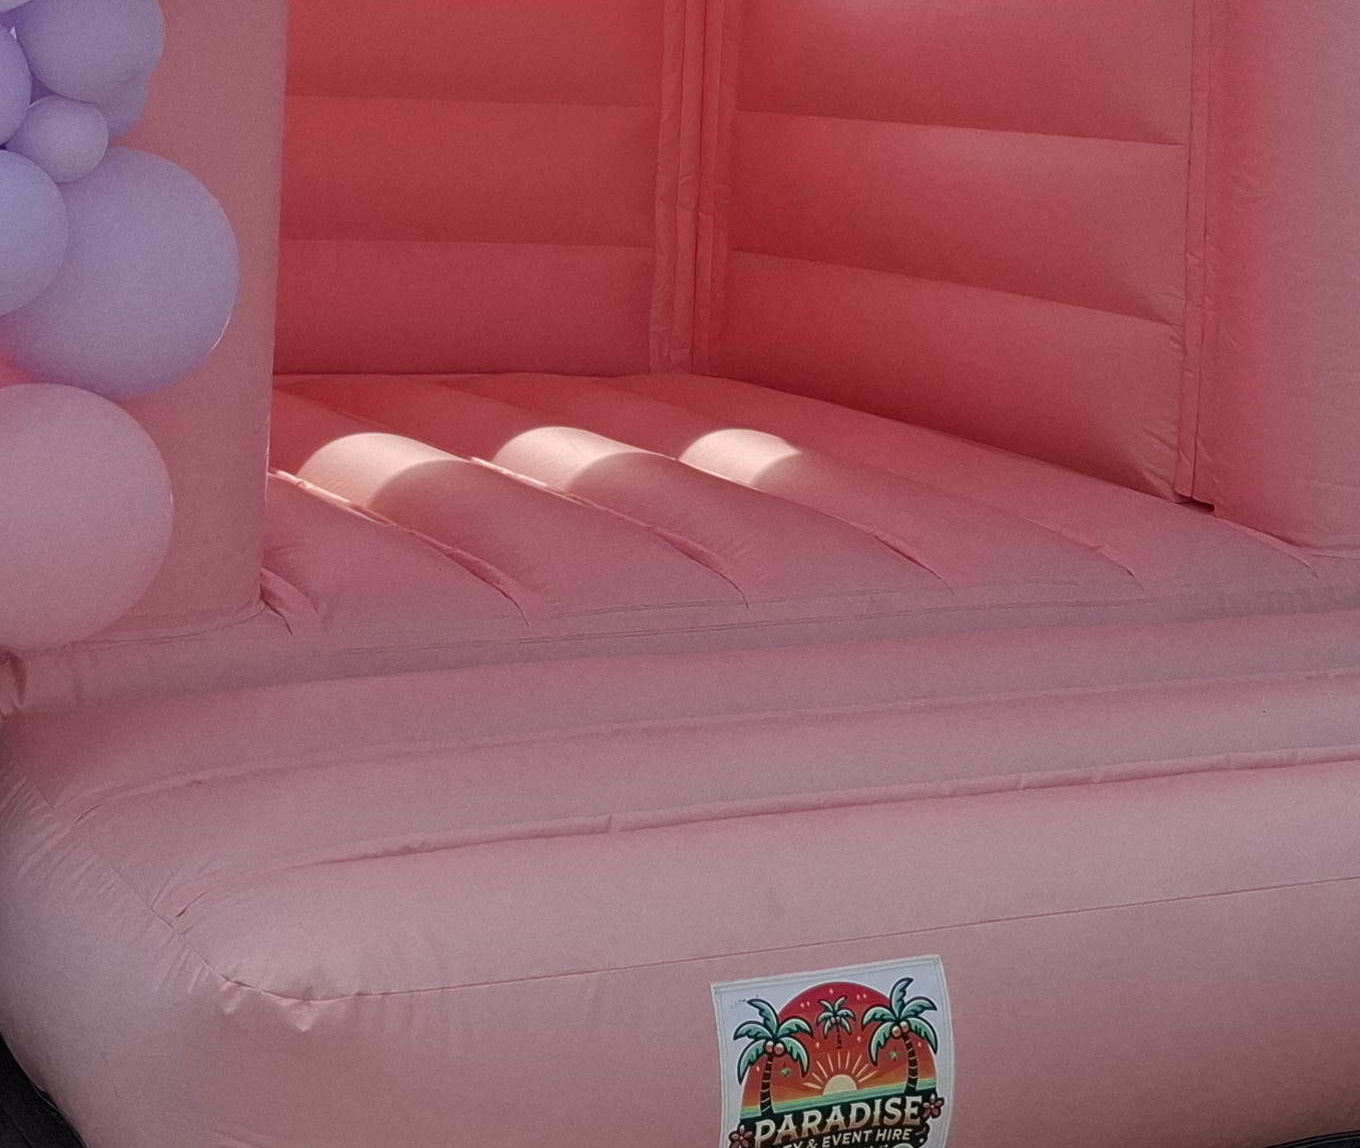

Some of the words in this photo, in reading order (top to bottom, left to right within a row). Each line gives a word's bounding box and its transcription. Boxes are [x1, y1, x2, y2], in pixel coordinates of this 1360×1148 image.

[754, 1096, 923, 1148] PARADISE
[821, 1130, 872, 1148] EVENT
[875, 1128, 913, 1142] HIRE
